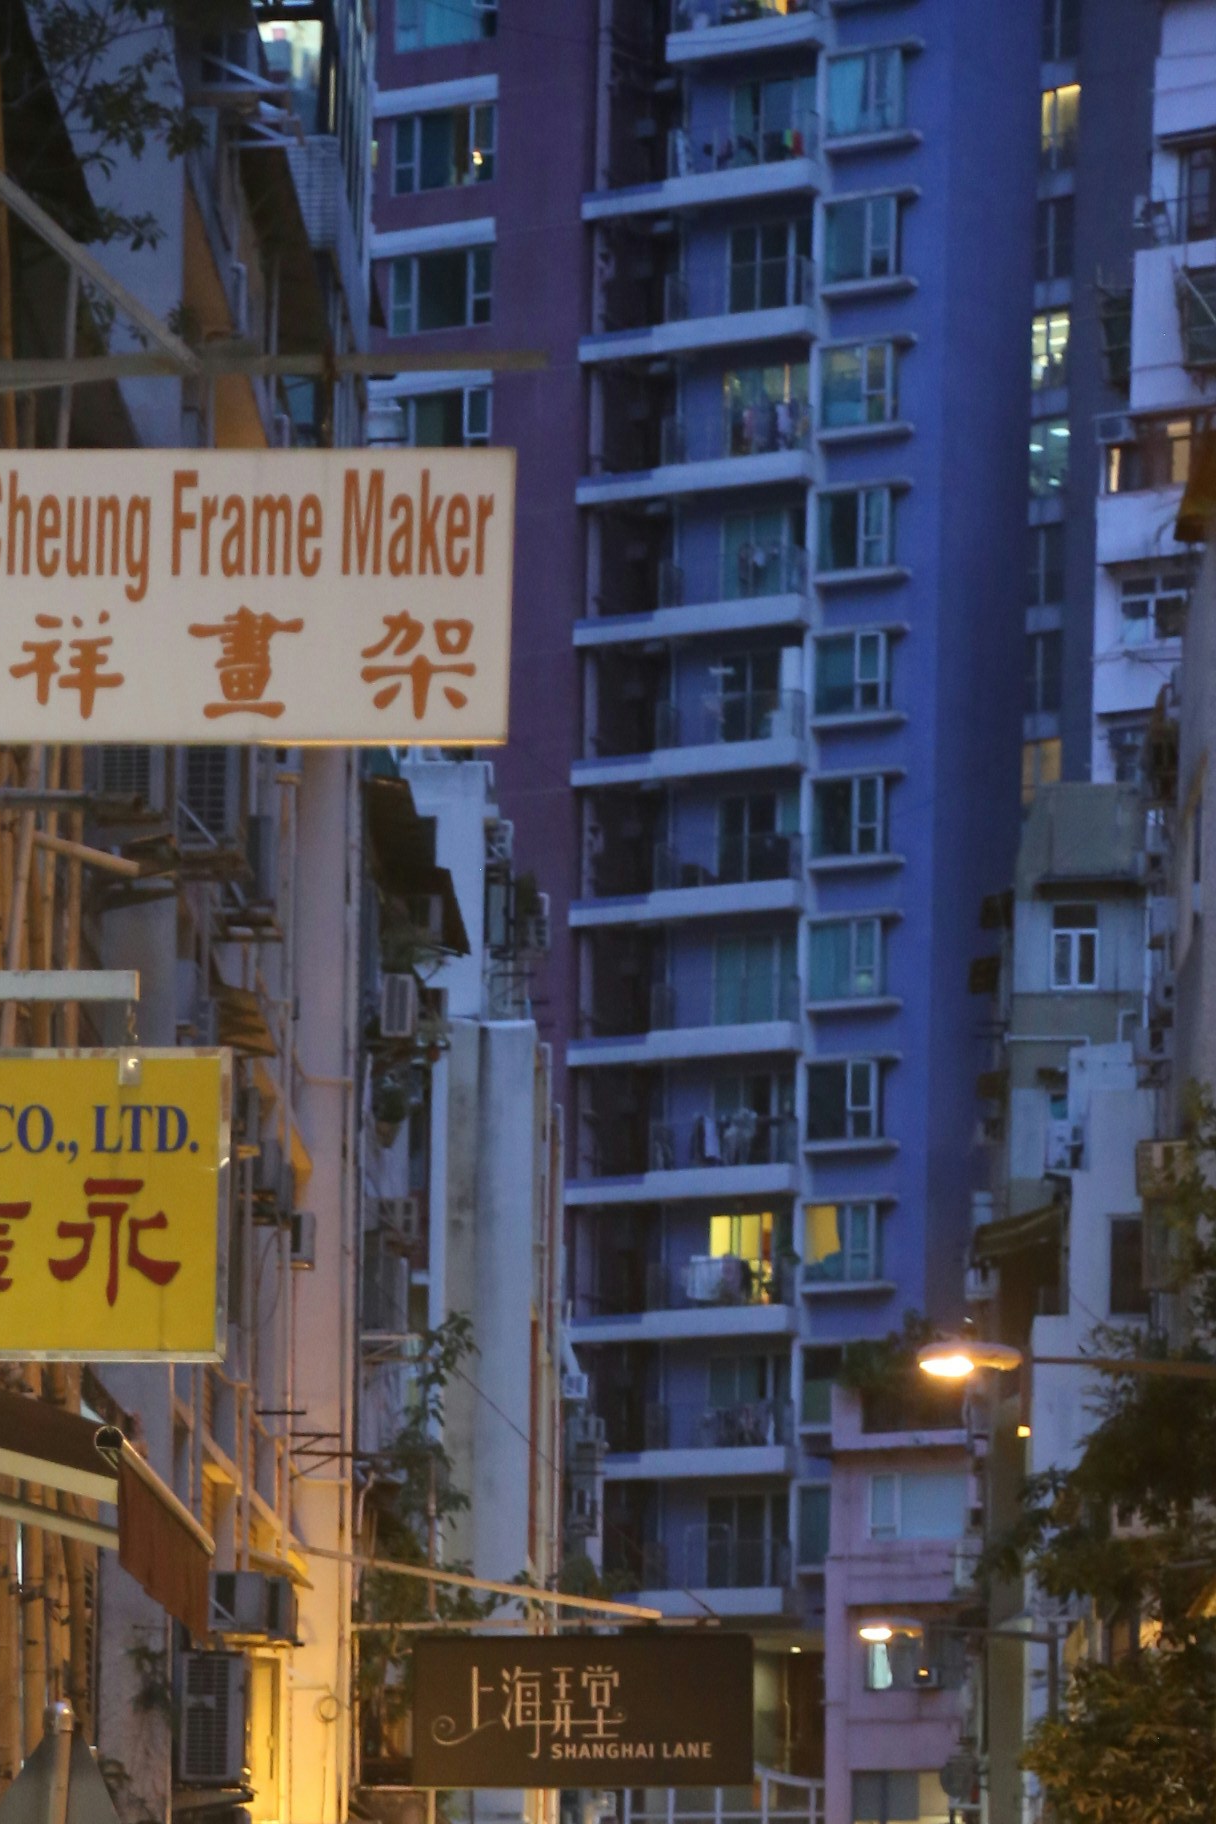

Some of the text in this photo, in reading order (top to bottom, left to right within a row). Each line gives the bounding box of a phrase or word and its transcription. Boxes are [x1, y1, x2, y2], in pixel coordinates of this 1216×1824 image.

[171, 469, 323, 578] Frame
[341, 468, 494, 577] Maker
[93, 1105, 200, 1154] LTD.
[551, 1742, 712, 1759] SHANGHAI LANE
